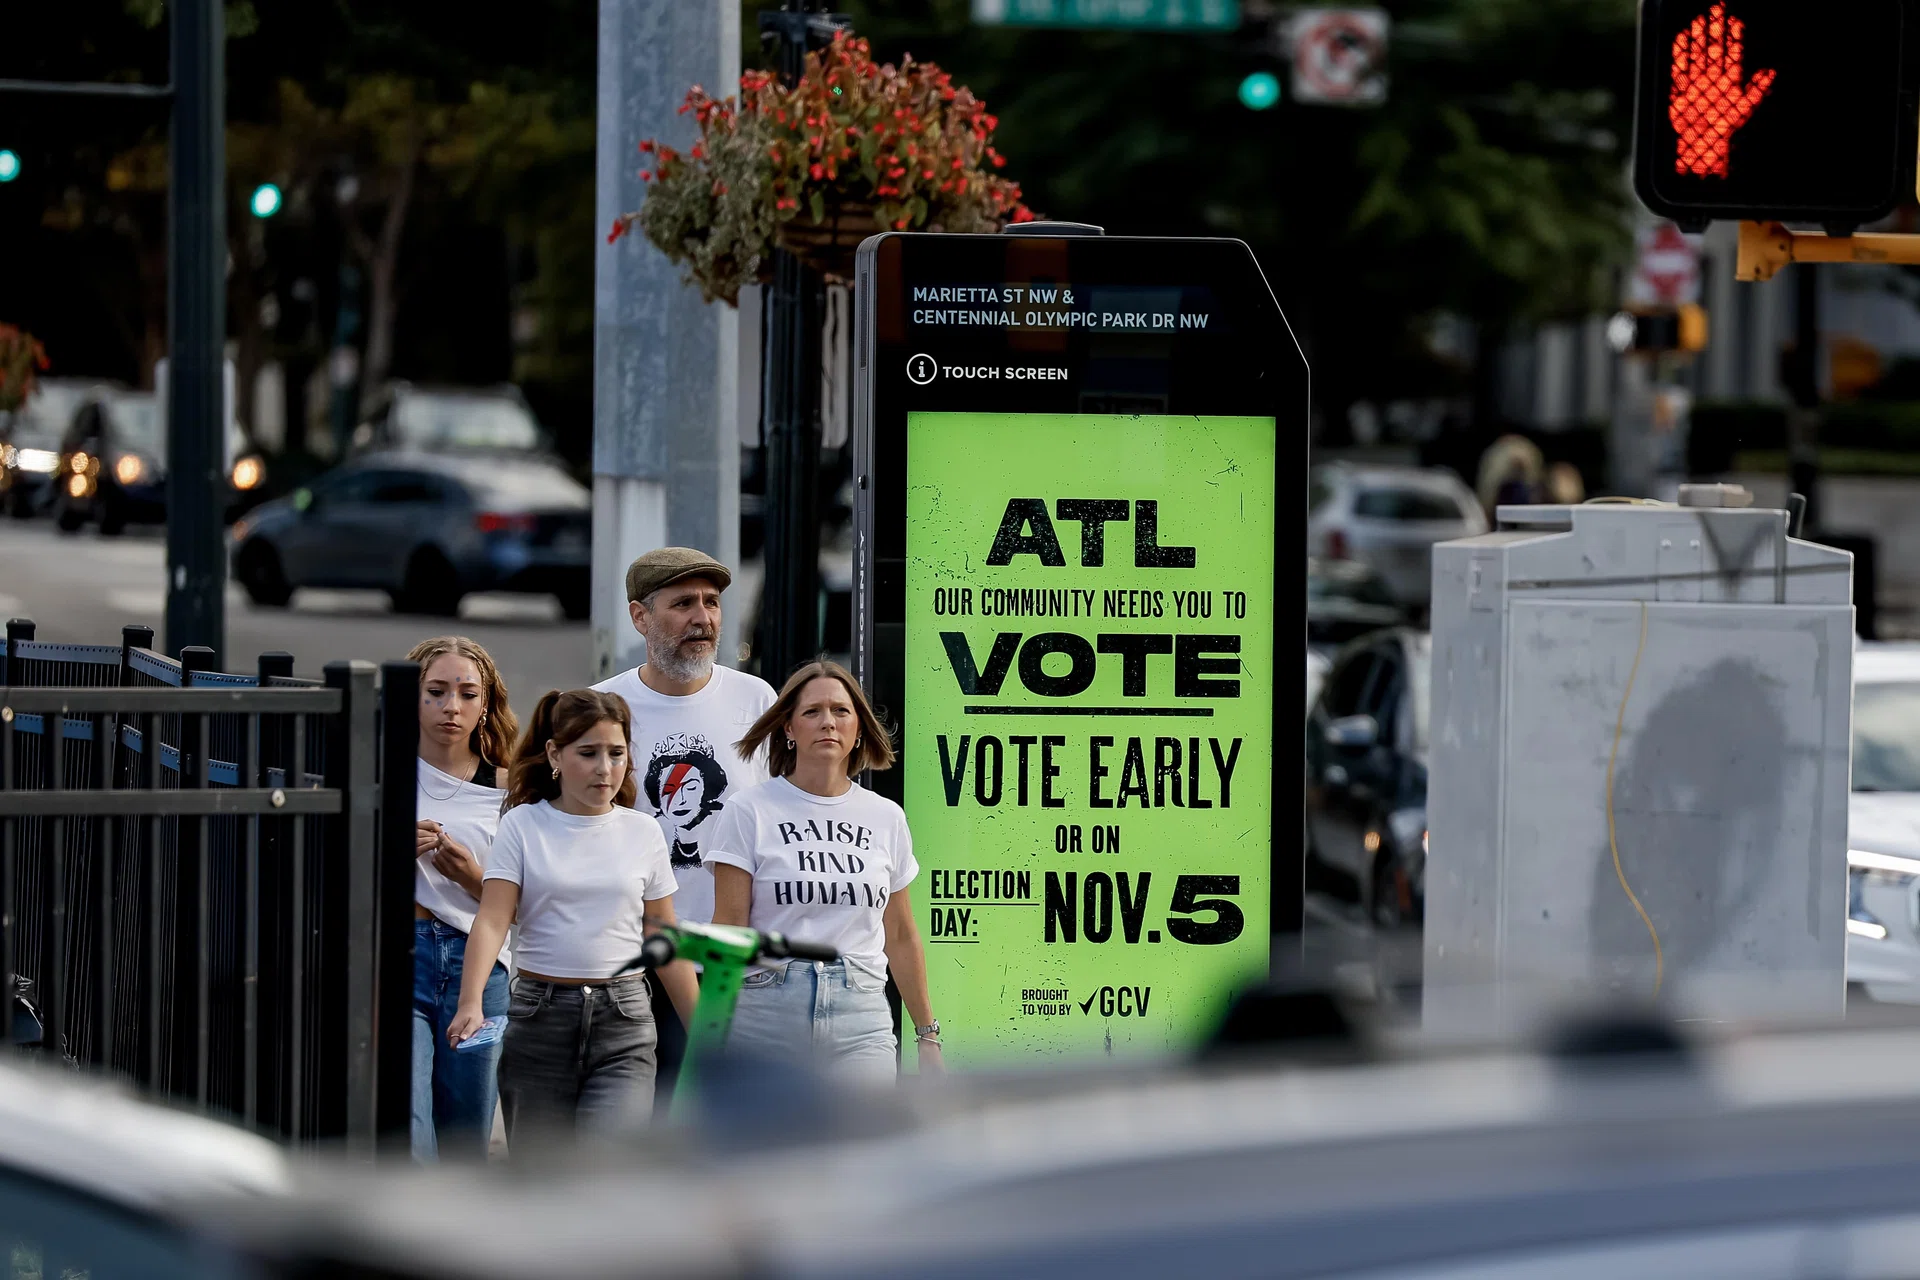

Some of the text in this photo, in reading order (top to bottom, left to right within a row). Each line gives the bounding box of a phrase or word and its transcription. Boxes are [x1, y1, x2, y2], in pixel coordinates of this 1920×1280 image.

[913, 287, 1075, 304] MARIETTA ST NW &
[913, 310, 1209, 328] CENTENNIAL OLYMPIC PARK DR NW
[943, 366, 1000, 379] TOUCH
[1005, 368, 1068, 380] SCREEN
[986, 498, 1196, 568] ATL
[934, 587, 1246, 619] OUR COMMUNITY NEEDS YOU TO
[939, 632, 1241, 698] VOTE
[936, 734, 1243, 809] VOTE EARLY
[777, 819, 873, 850] RAISE
[1055, 825, 1120, 854] OR ON
[797, 850, 865, 874] KIND
[774, 880, 888, 910] HUMANS
[930, 870, 1031, 899] ELECTION
[930, 908, 978, 937] DAY:
[1022, 989, 1069, 1000] BROUGHT
[1100, 986, 1151, 1017] GCV
[1022, 1004, 1071, 1016] TO YOU BY
